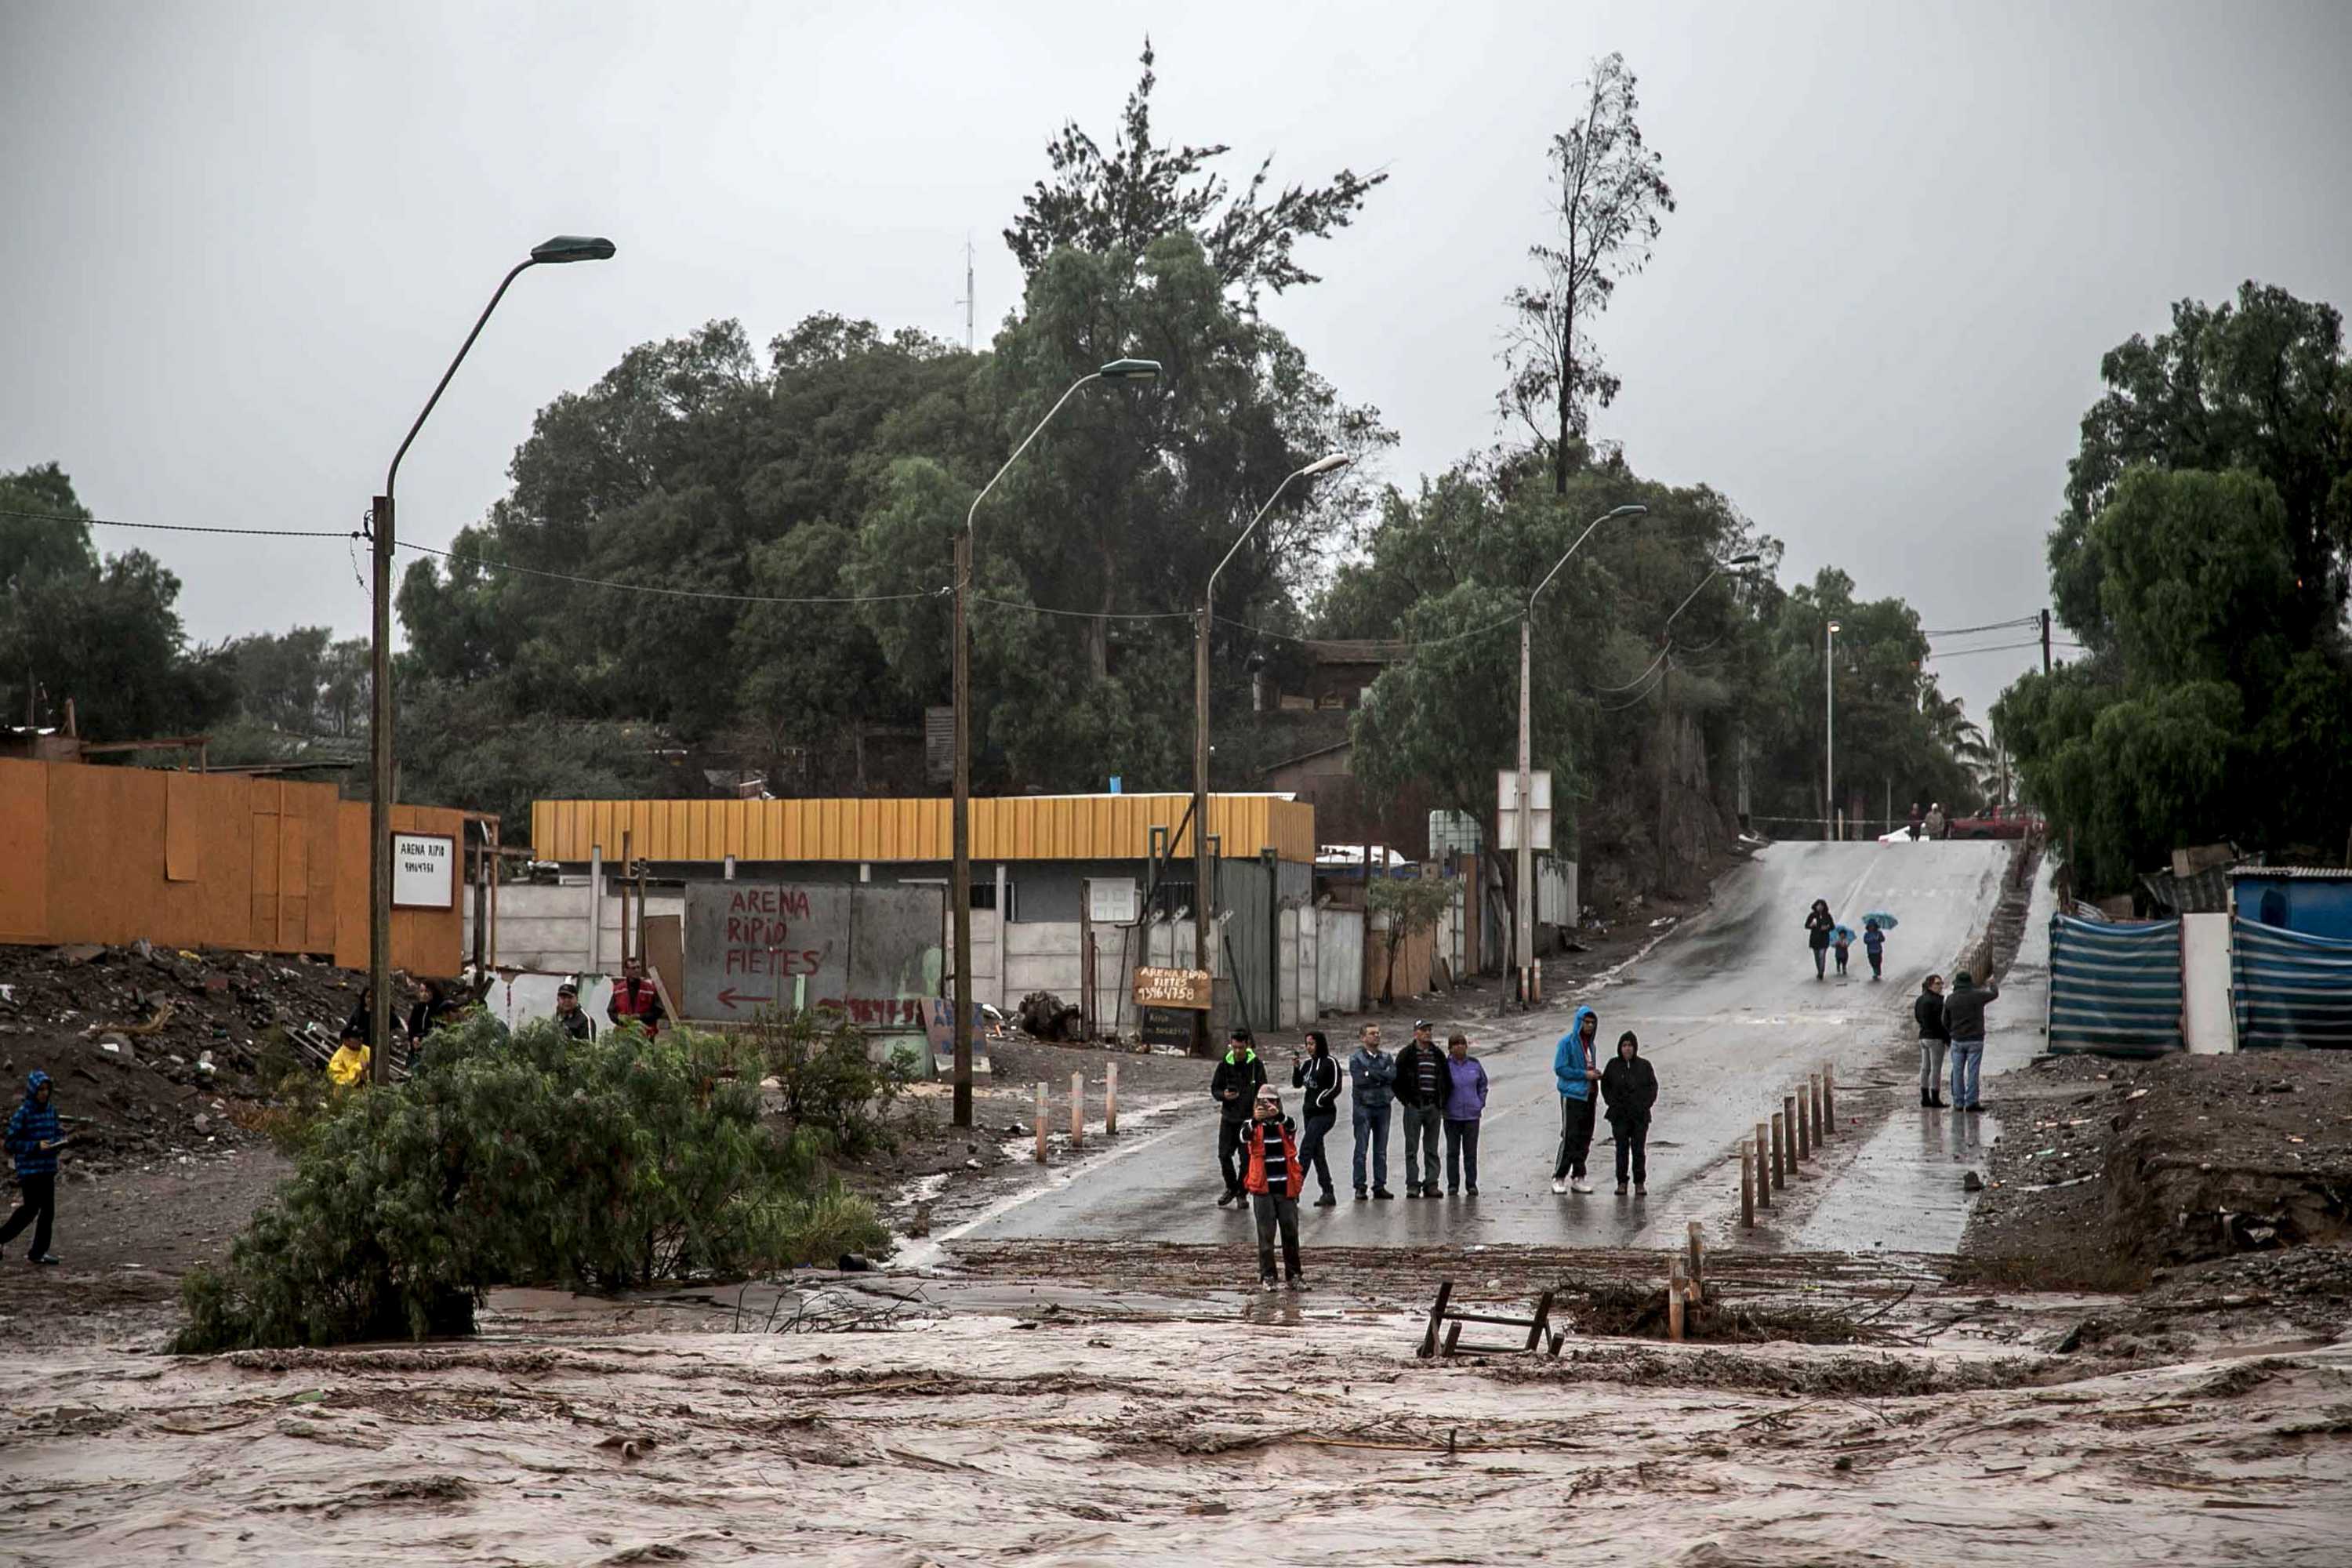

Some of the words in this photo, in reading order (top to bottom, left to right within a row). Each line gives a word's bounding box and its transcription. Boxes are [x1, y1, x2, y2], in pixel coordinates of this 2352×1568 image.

[401, 843, 425, 856] ARENA
[728, 890, 811, 920] ARENA
[726, 949, 821, 977] FIETES
[1141, 967, 1178, 977] ARENA
